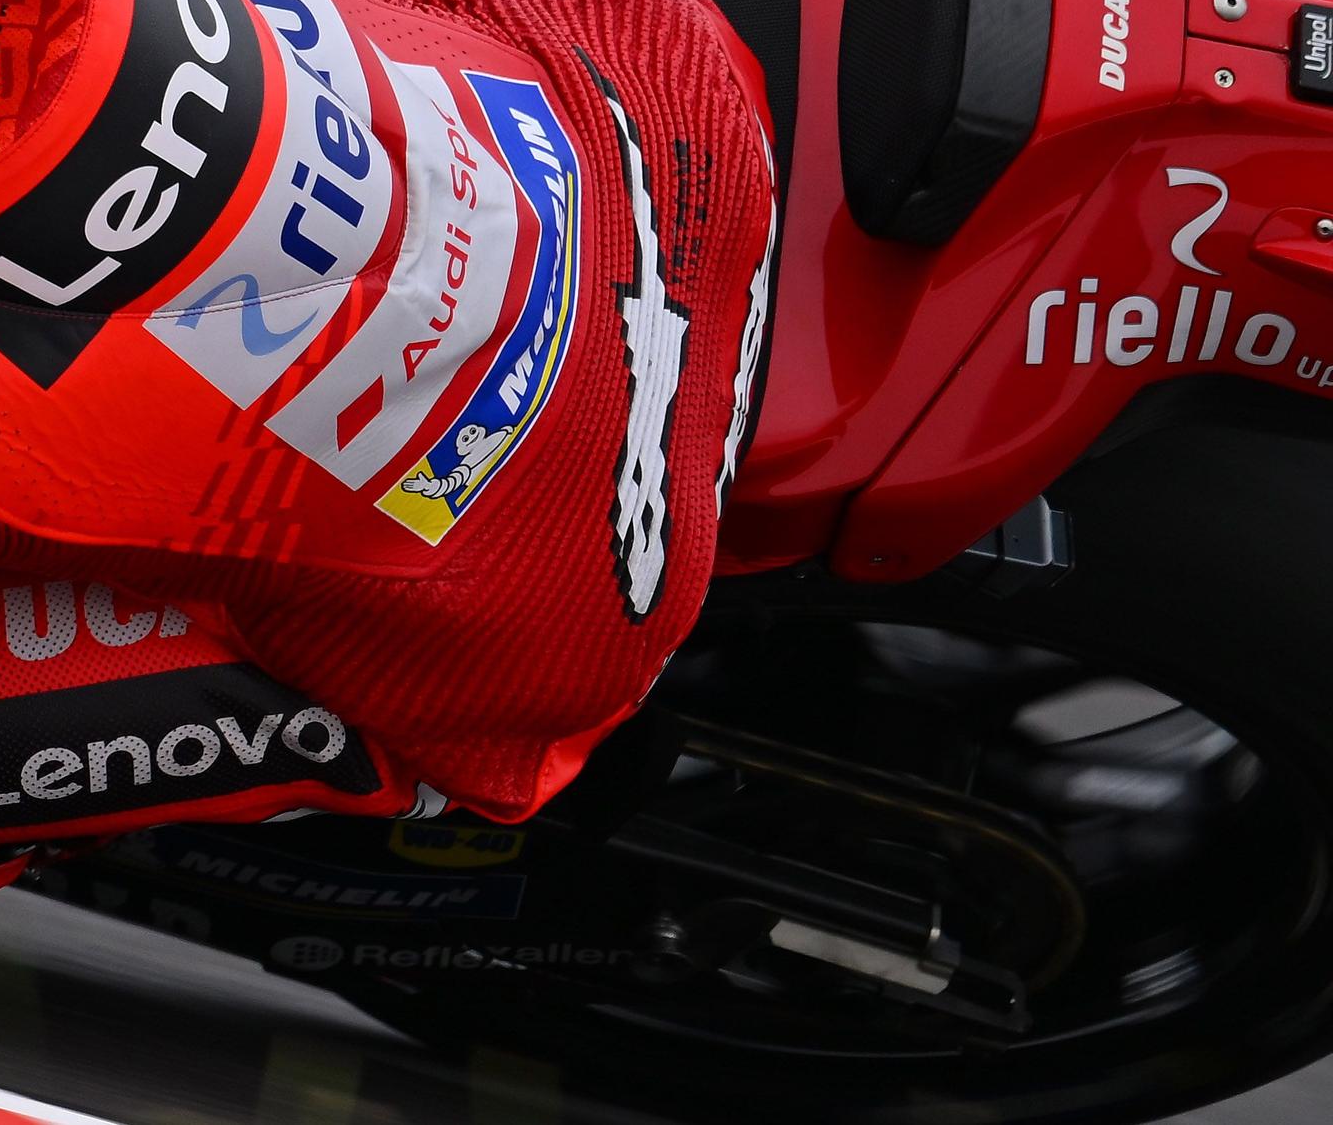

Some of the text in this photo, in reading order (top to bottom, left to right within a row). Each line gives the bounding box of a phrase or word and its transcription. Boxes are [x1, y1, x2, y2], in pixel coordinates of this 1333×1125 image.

[1303, 12, 1332, 73] Unipol
[402, 222, 472, 382] Audi
[1025, 278, 1333, 387] riello up
[179, 851, 480, 909] MICHELIN
